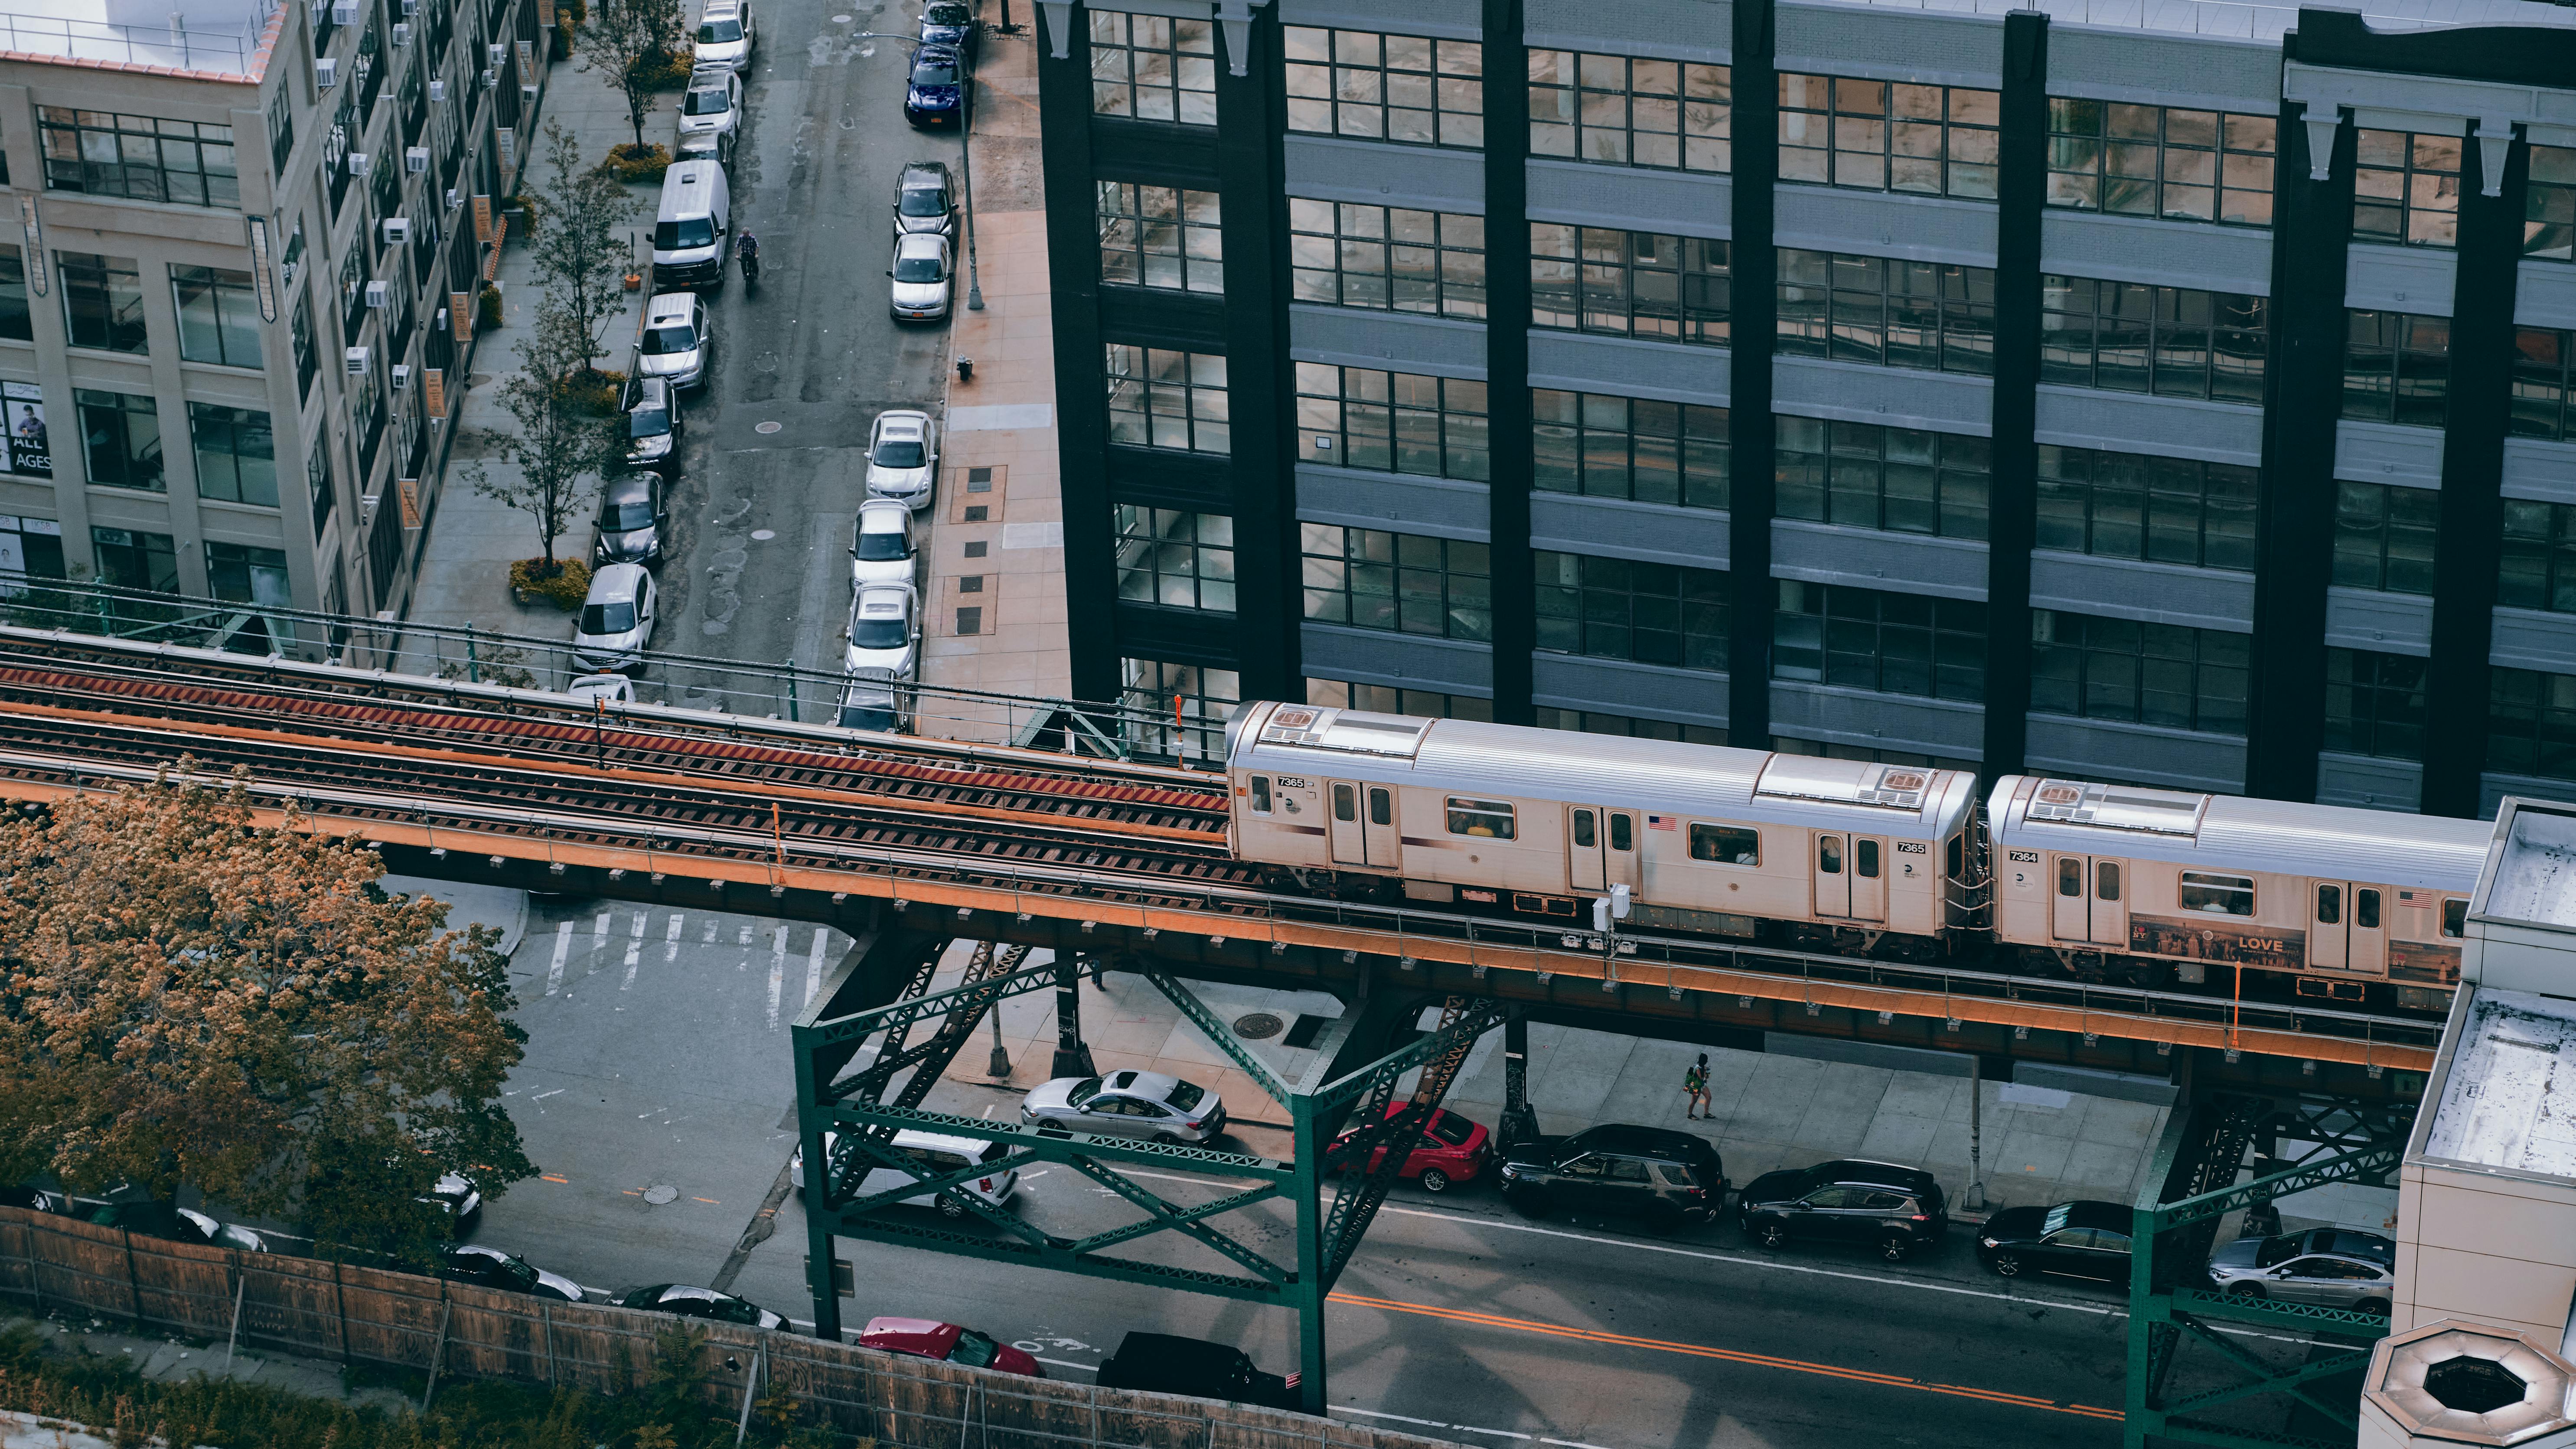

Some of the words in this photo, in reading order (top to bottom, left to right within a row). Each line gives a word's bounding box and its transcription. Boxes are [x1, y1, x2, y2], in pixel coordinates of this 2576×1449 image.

[13, 437, 42, 449] ALL
[16, 454, 52, 469] AGES
[1279, 777, 1304, 787] 7365
[1899, 842, 1925, 853] 7365
[2011, 851, 2037, 862] 7364
[2239, 937, 2283, 952] LOVE
